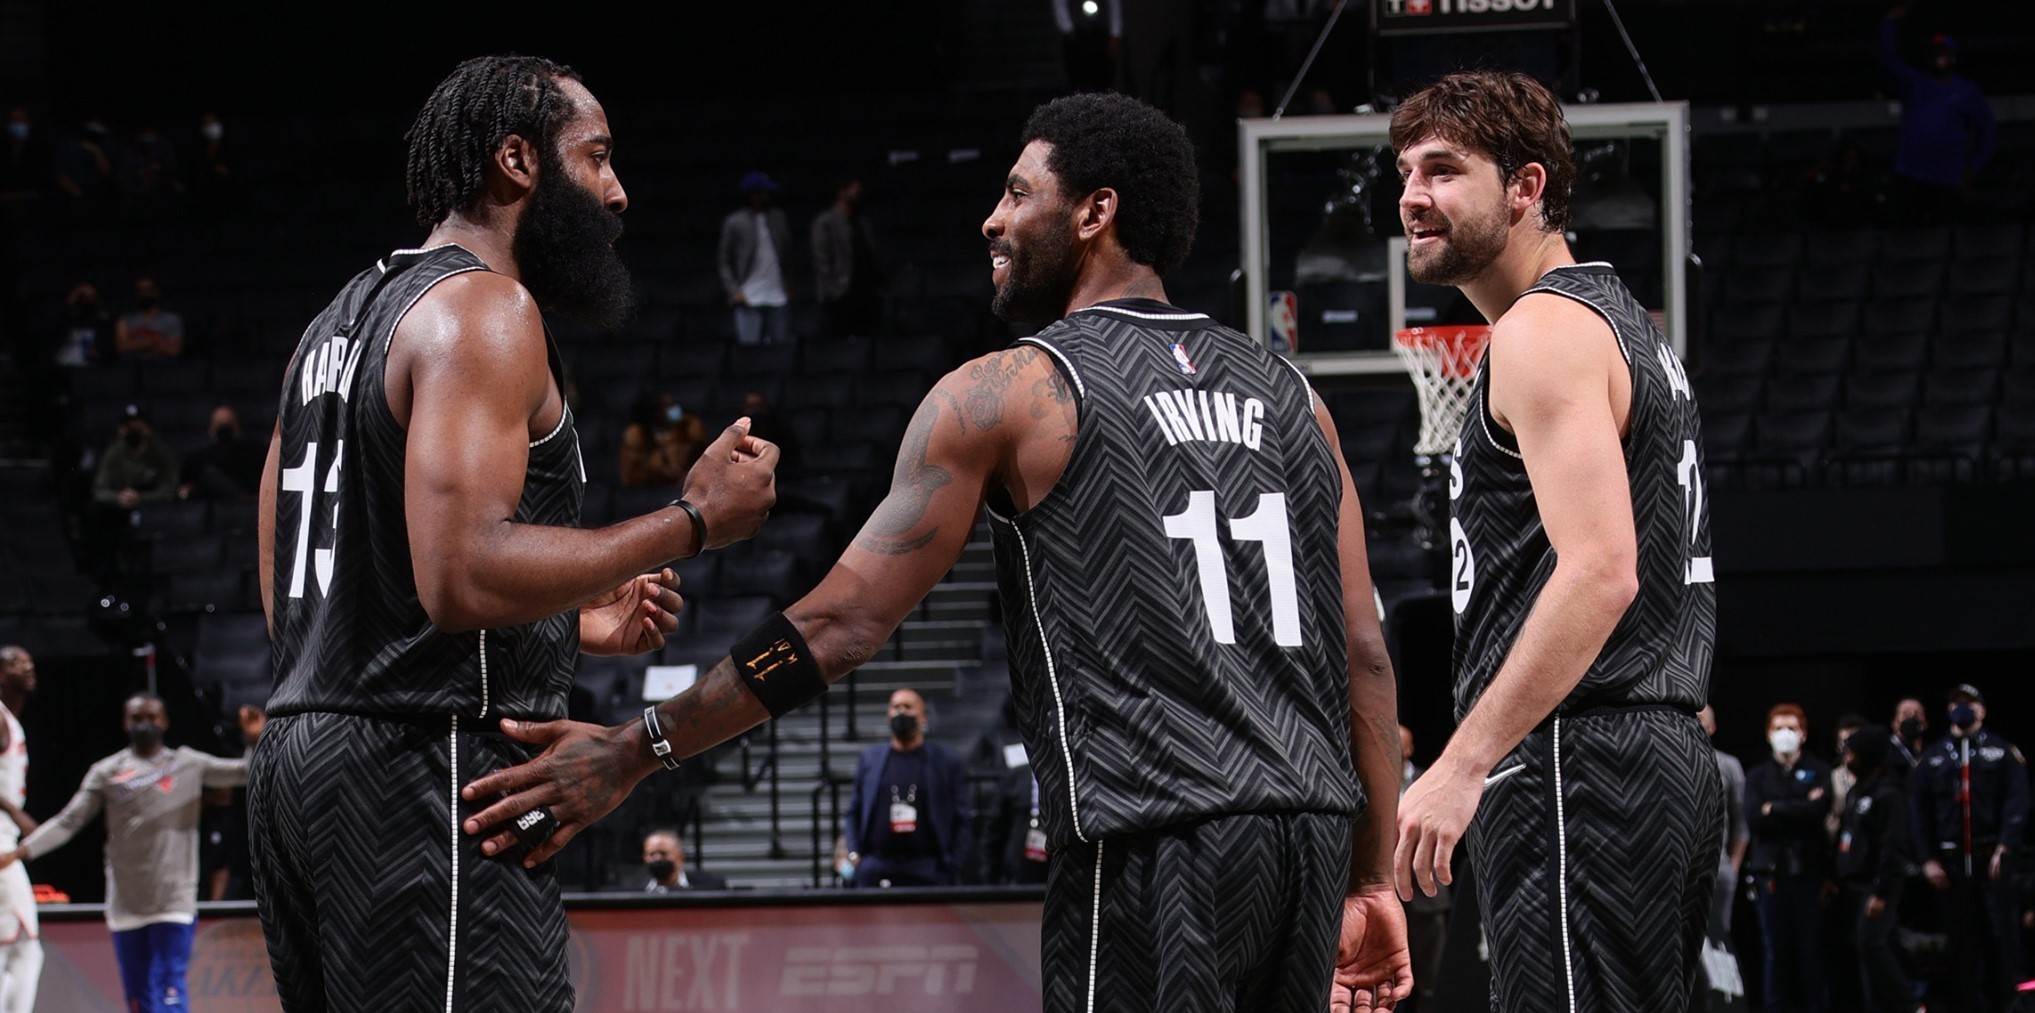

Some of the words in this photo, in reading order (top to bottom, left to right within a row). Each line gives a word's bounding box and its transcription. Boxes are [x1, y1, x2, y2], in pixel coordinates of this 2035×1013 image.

[1143, 388, 1264, 452] IRVING
[1162, 490, 1303, 647] 11
[624, 932, 750, 1012] NEXT
[780, 944, 980, 996] ESPN
